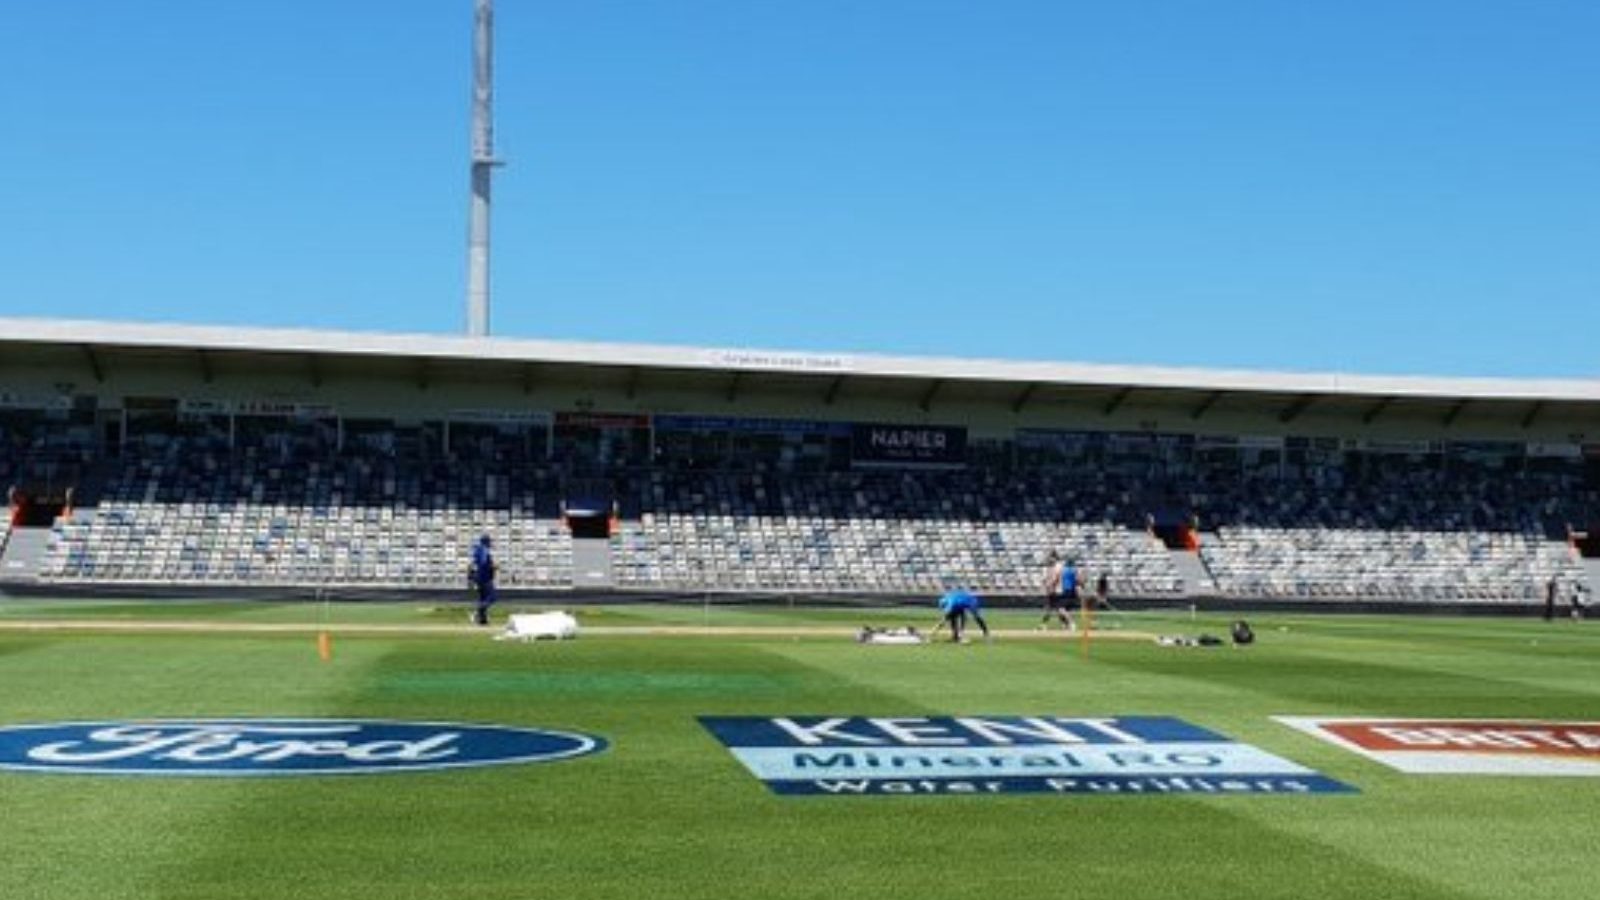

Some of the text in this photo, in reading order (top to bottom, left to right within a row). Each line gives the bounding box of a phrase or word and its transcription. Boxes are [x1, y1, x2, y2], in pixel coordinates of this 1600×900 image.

[871, 430, 947, 449] NAPIER
[771, 717, 1146, 745] KENT
[27, 724, 461, 762] Ford
[794, 752, 1222, 768] Mineral RO
[815, 778, 1310, 793] Water Purifiers
